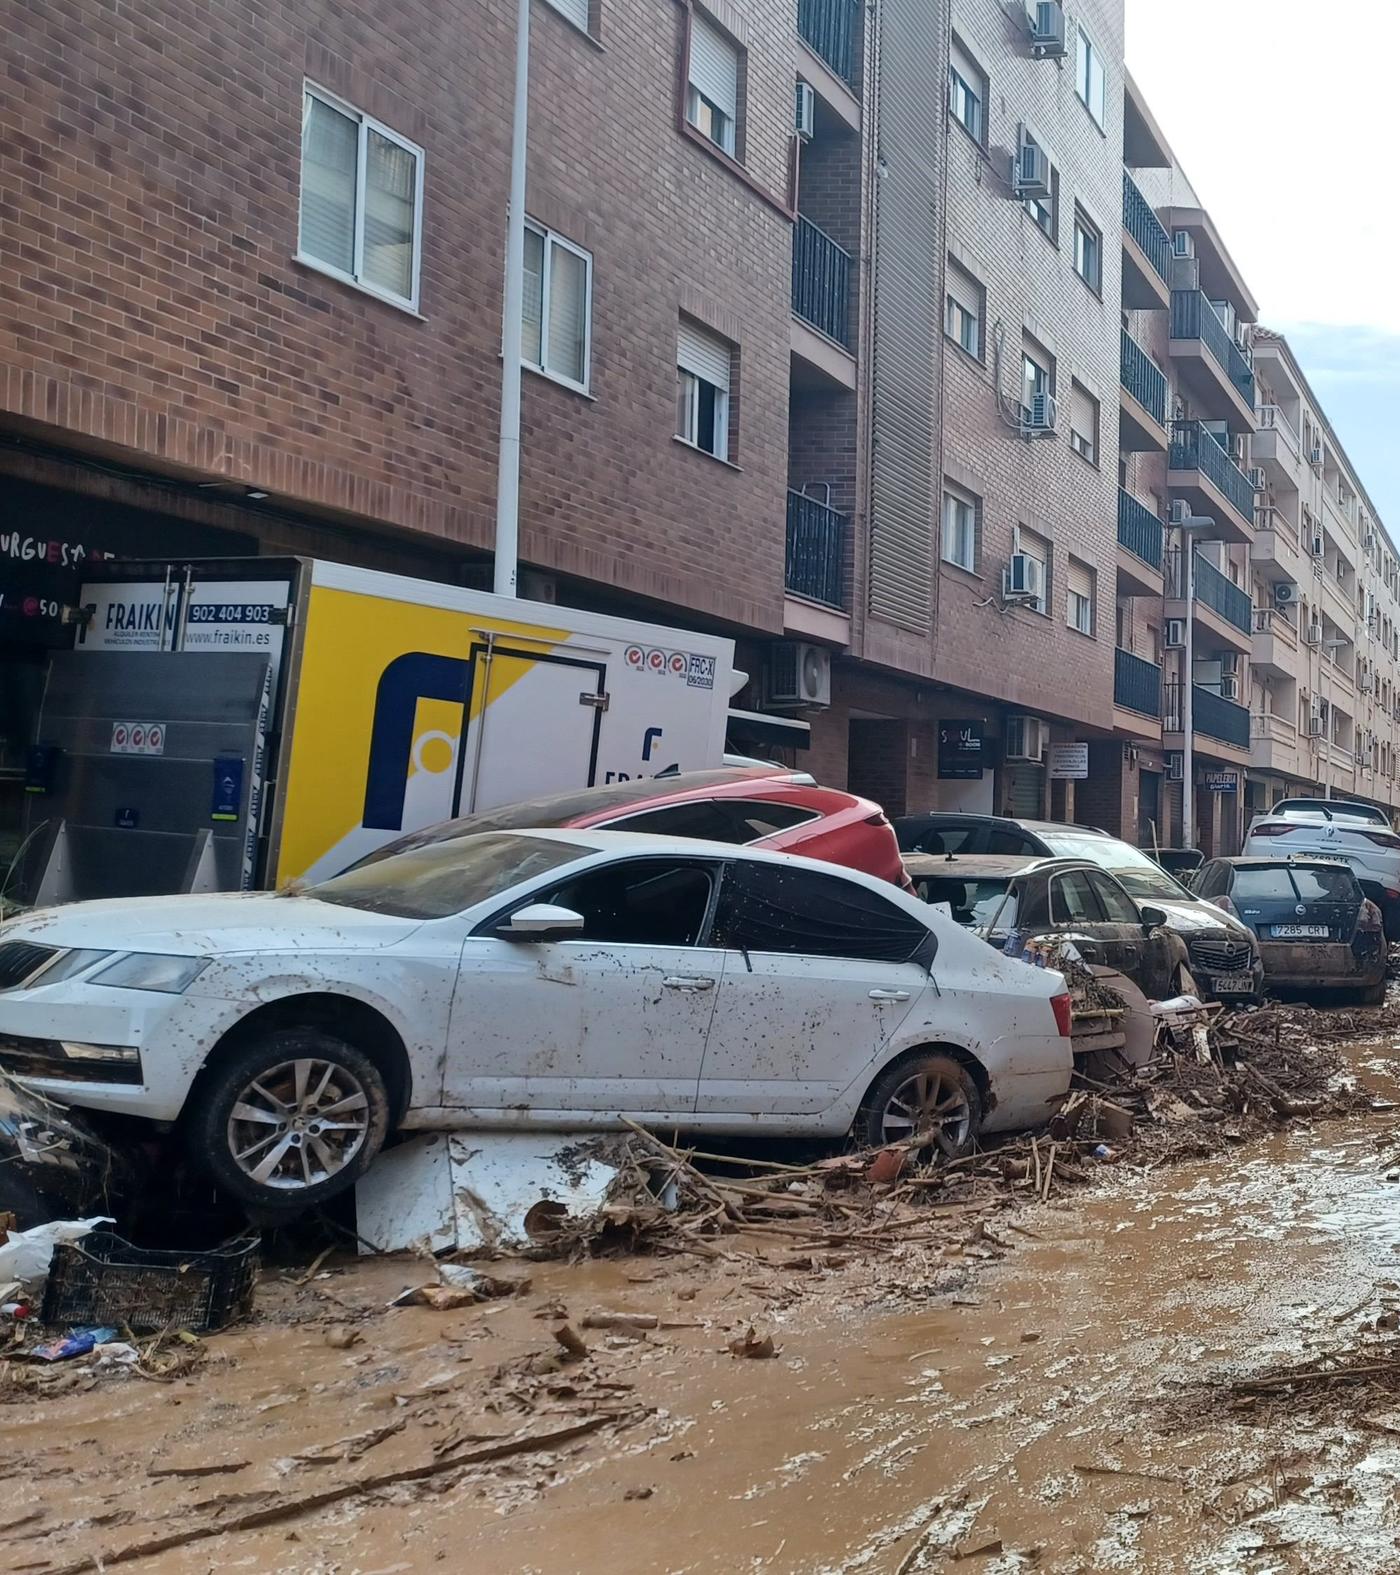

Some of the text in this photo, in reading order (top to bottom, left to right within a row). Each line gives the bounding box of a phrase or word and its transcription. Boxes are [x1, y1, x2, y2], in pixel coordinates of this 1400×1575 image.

[106, 603, 175, 631] FRAIKIN
[192, 606, 270, 621] 902 404 903
[185, 630, 270, 646] www.fraikin.es
[941, 728, 980, 743] SUL
[1277, 925, 1326, 935] 7285 CRT
